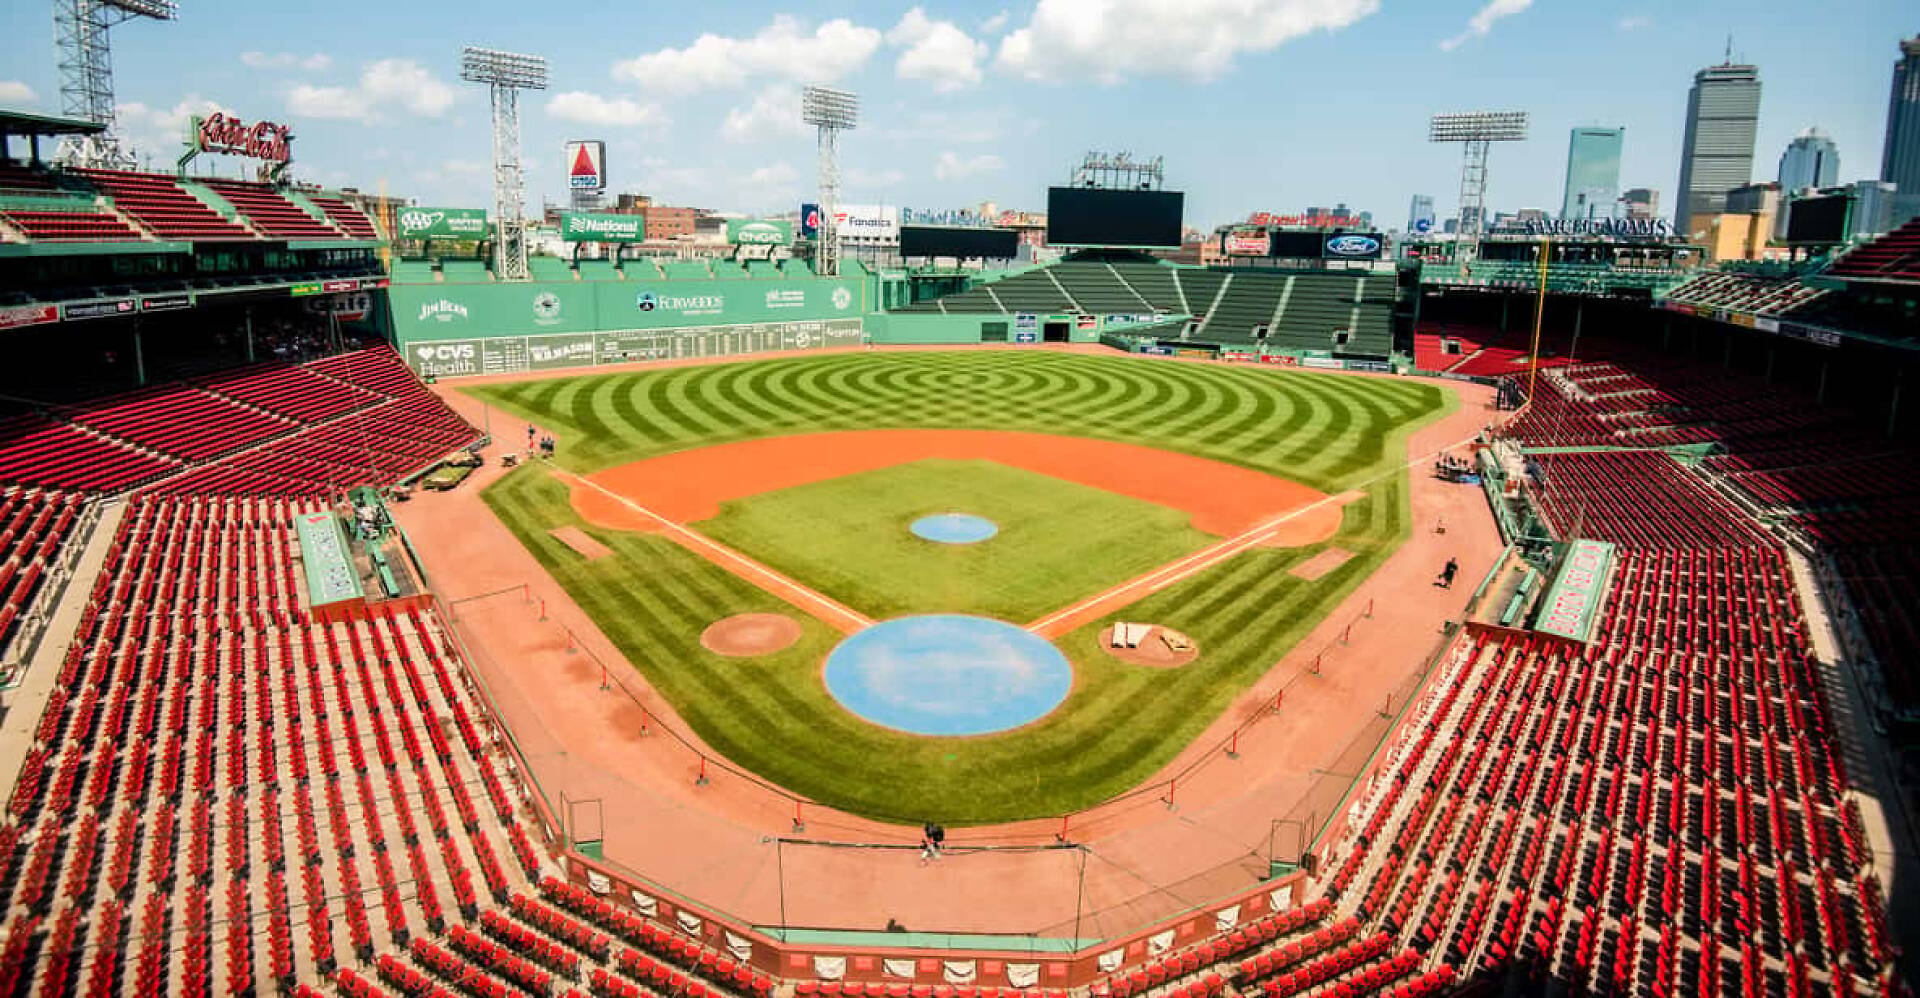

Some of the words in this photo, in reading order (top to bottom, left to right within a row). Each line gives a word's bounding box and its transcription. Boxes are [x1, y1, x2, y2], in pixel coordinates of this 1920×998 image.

[200, 112, 290, 161] Coca-Cola
[587, 219, 638, 231] National
[849, 217, 891, 227] Fanatics
[1526, 219, 1591, 235] SAMUEL
[1604, 218, 1667, 236] ADAMS
[437, 344, 474, 359] CVS
[420, 360, 475, 375] Health
